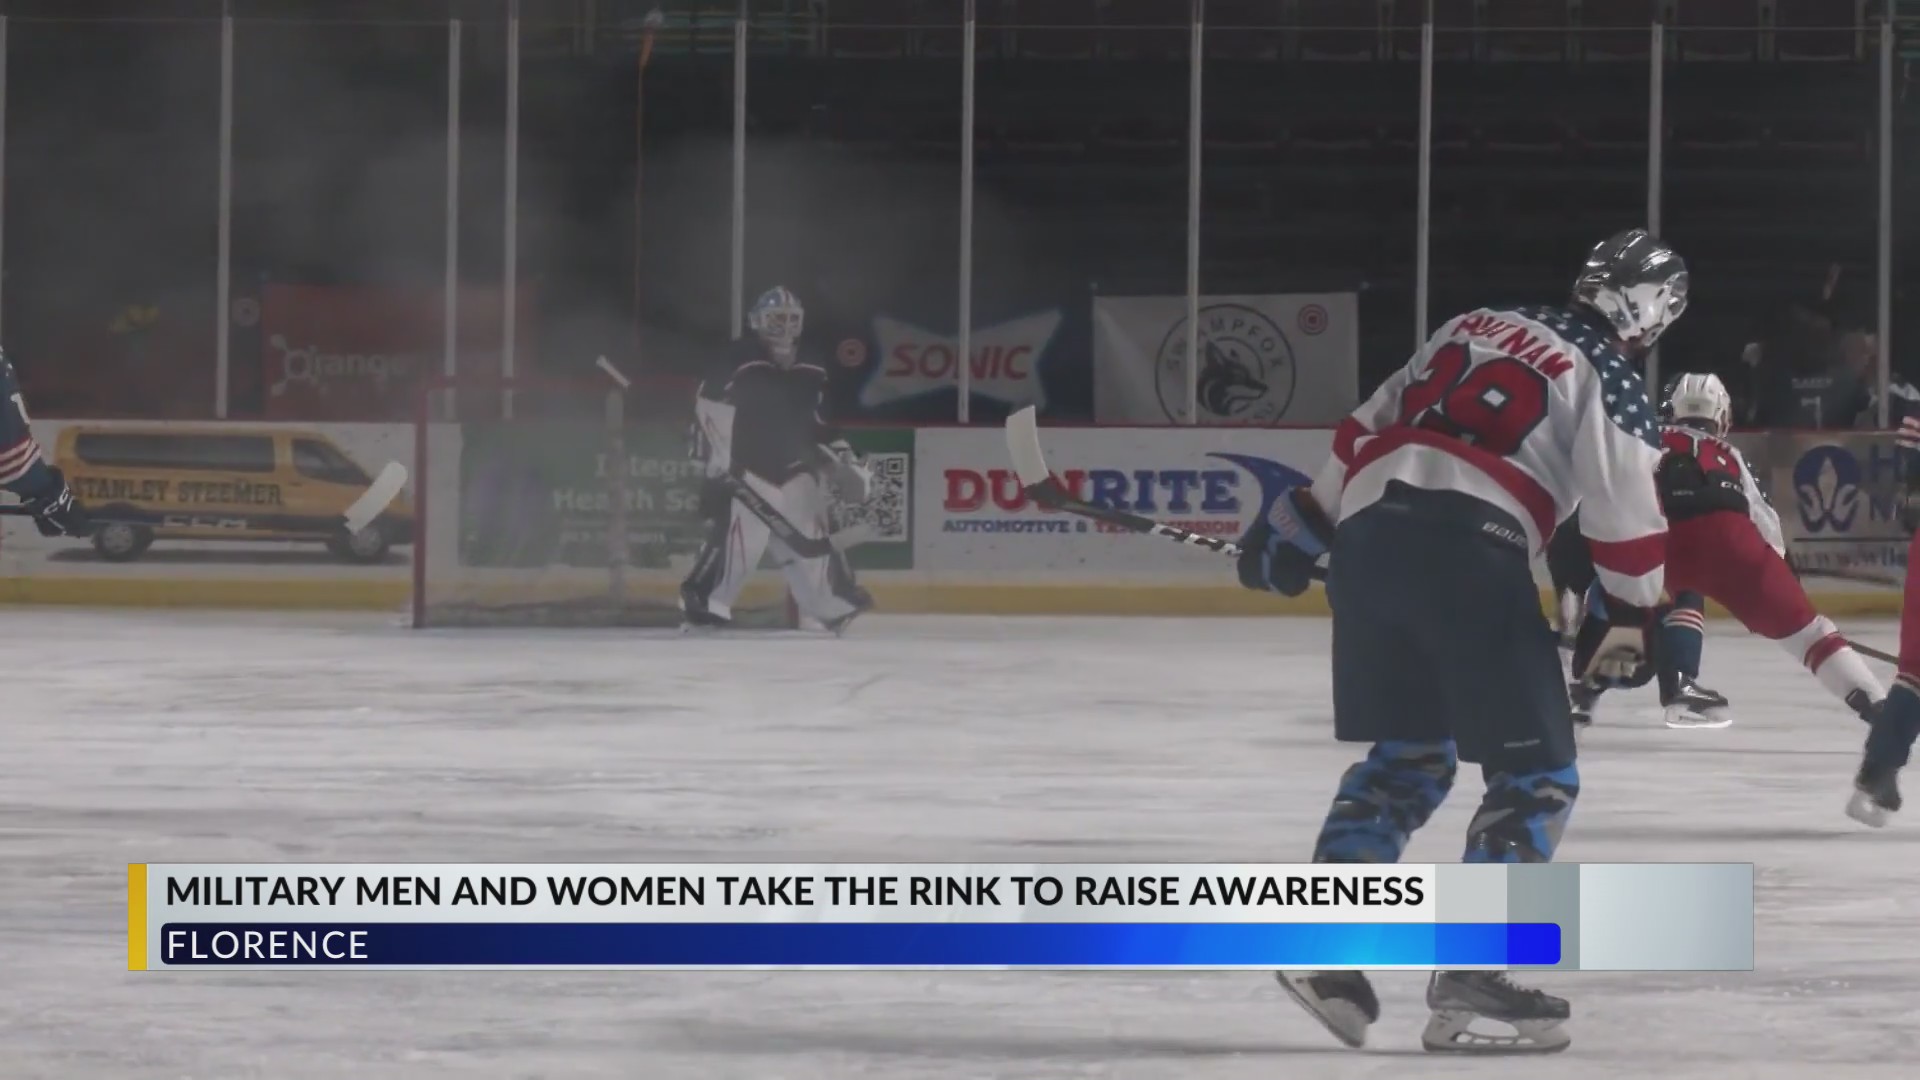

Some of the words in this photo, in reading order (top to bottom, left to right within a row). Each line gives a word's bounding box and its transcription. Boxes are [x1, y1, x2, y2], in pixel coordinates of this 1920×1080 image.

[885, 343, 1033, 381] SONIC
[1166, 316, 1284, 372] SWMPFOX
[1451, 315, 1575, 380] PUTNAM
[942, 520, 1071, 534] AUTOMOTIVE
